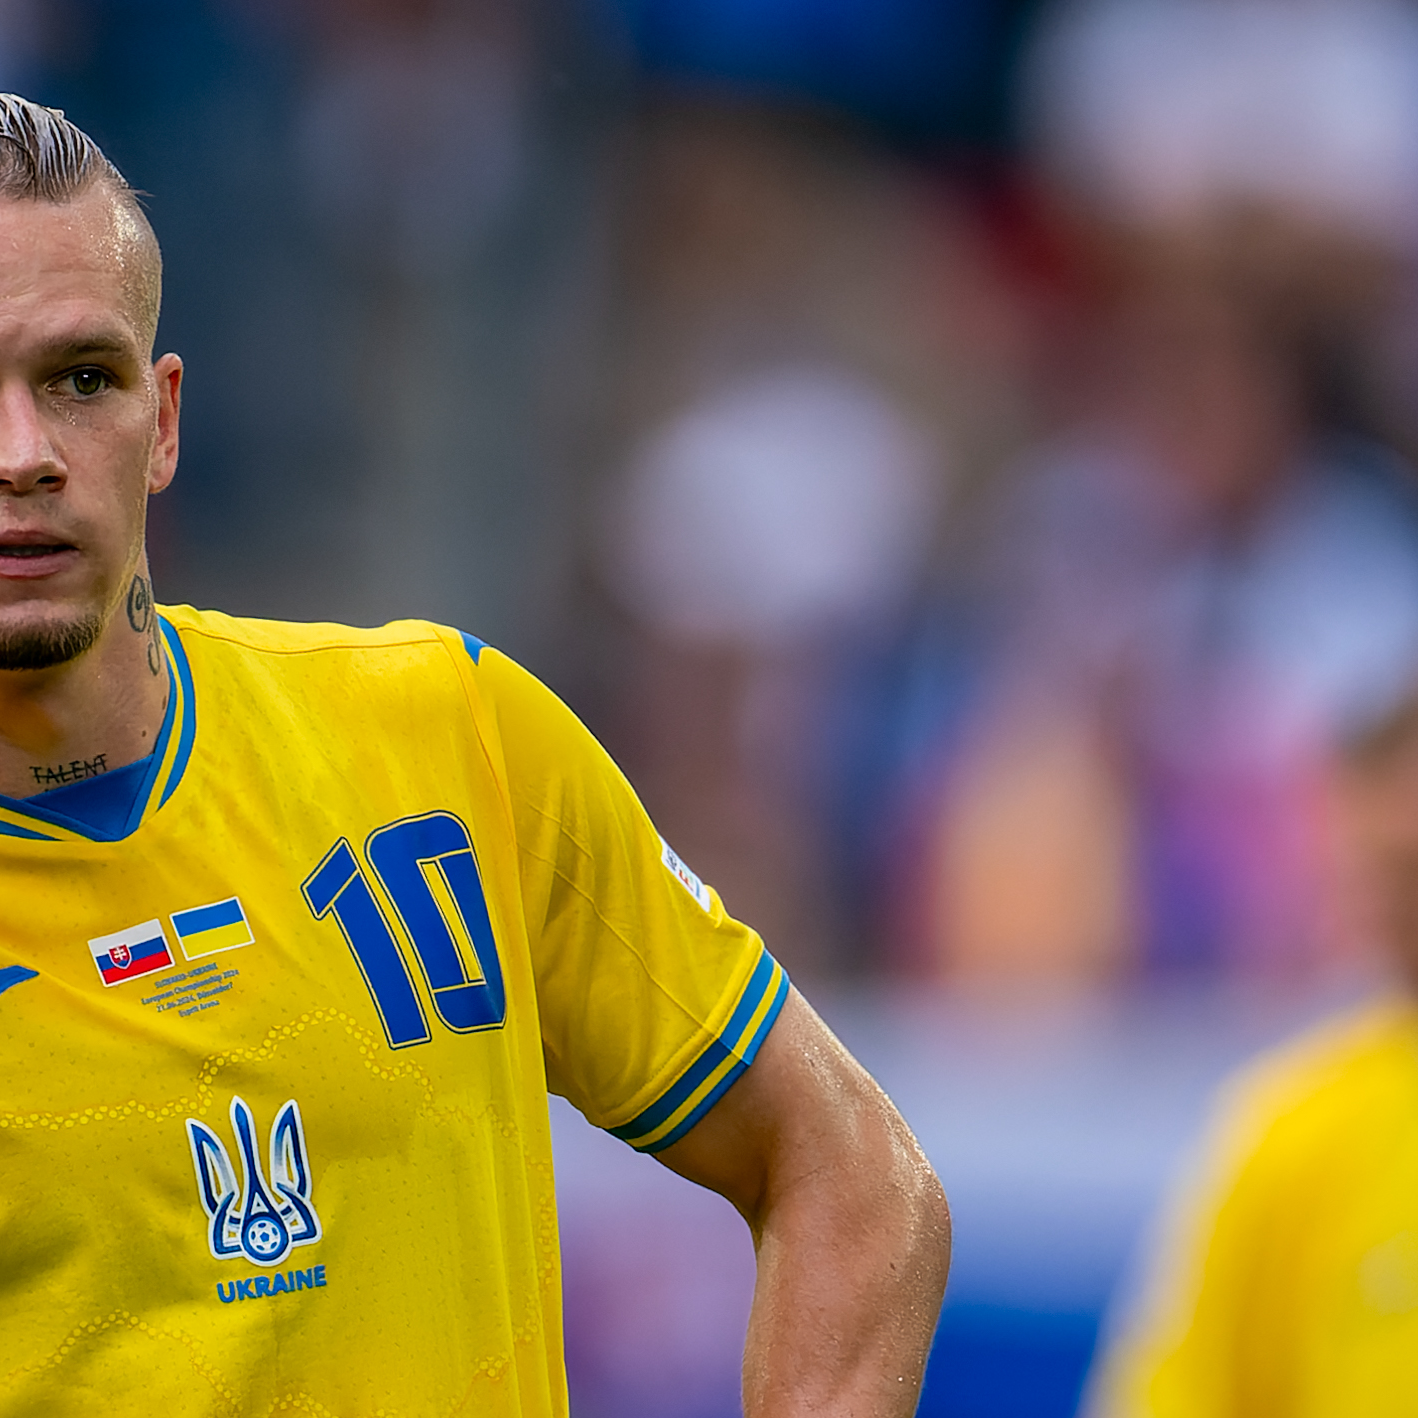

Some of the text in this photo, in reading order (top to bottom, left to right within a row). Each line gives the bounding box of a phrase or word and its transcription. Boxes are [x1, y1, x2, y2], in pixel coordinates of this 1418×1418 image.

[30, 753, 107, 784] TALENT
[300, 809, 507, 1050] 10
[216, 1264, 327, 1304] UKRAINE
